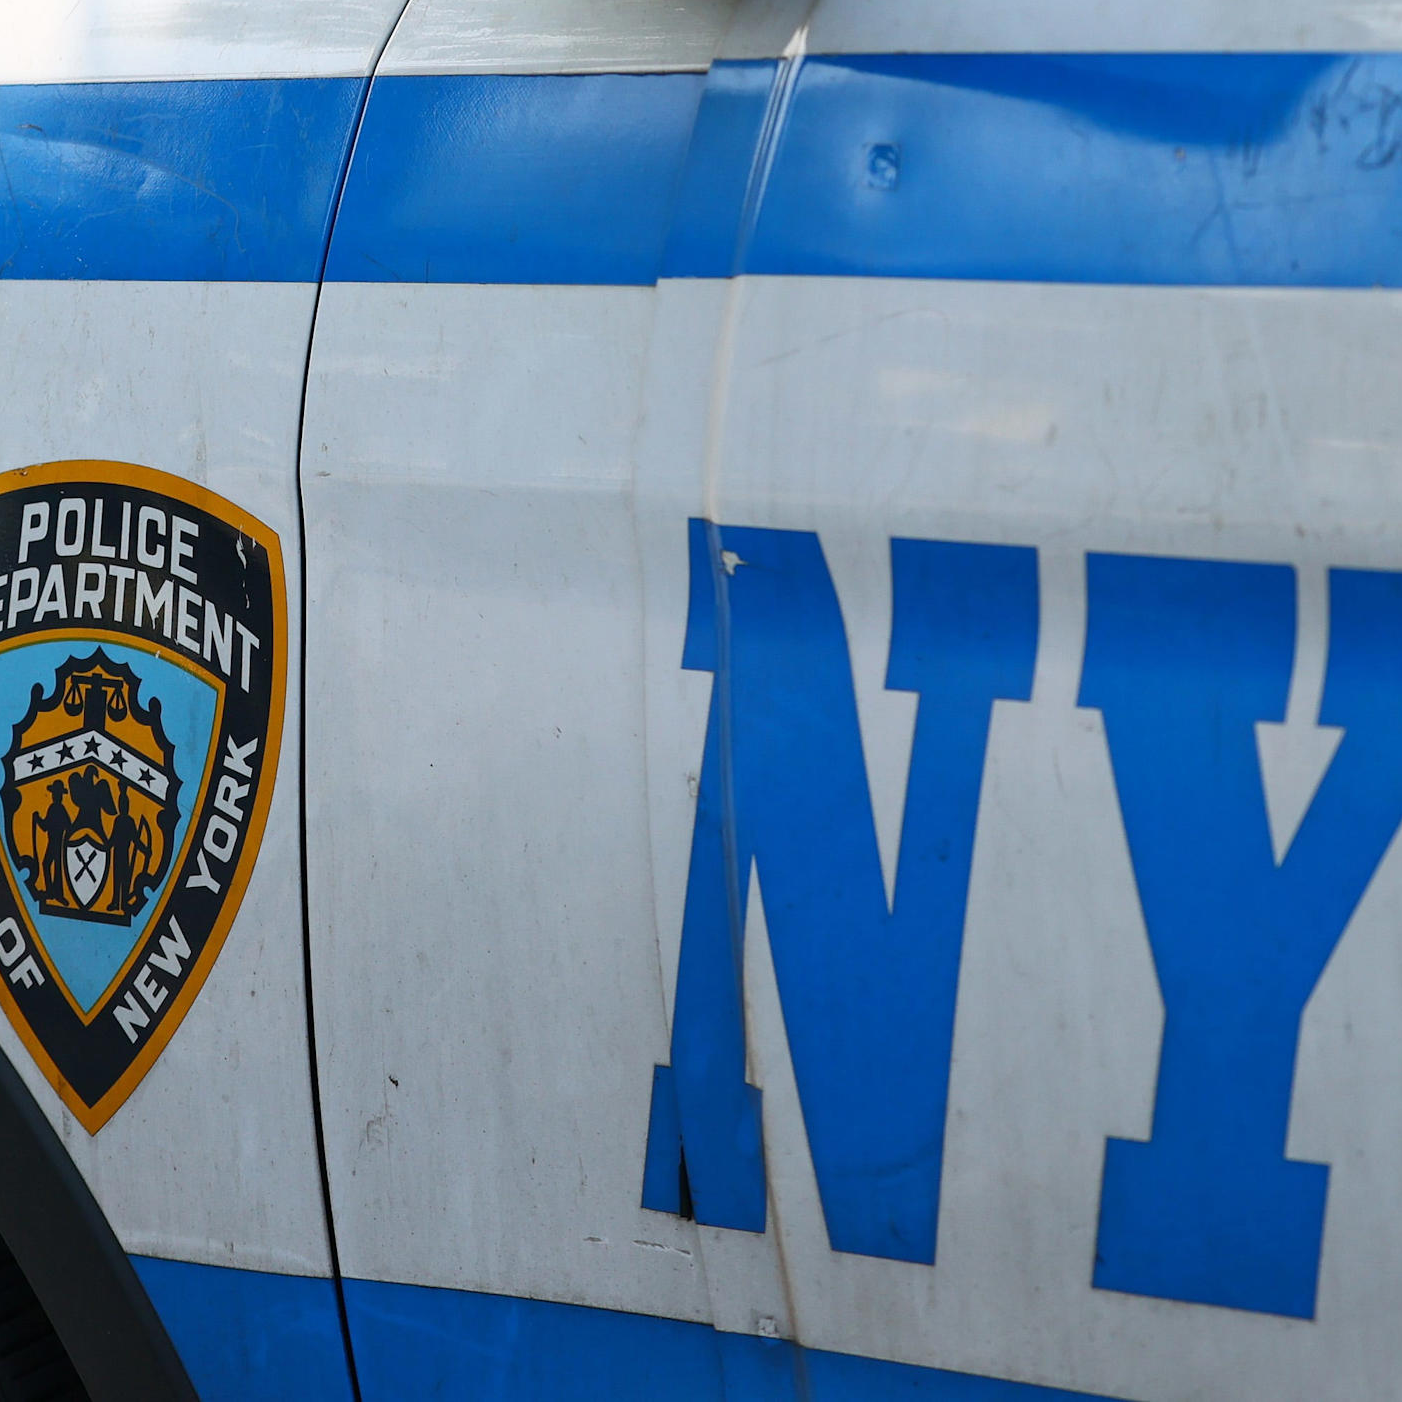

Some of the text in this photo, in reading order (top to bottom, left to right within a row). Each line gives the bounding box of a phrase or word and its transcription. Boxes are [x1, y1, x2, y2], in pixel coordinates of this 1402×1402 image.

[18, 497, 199, 586] POLICE
[112, 733, 260, 1046] NEW YORK
